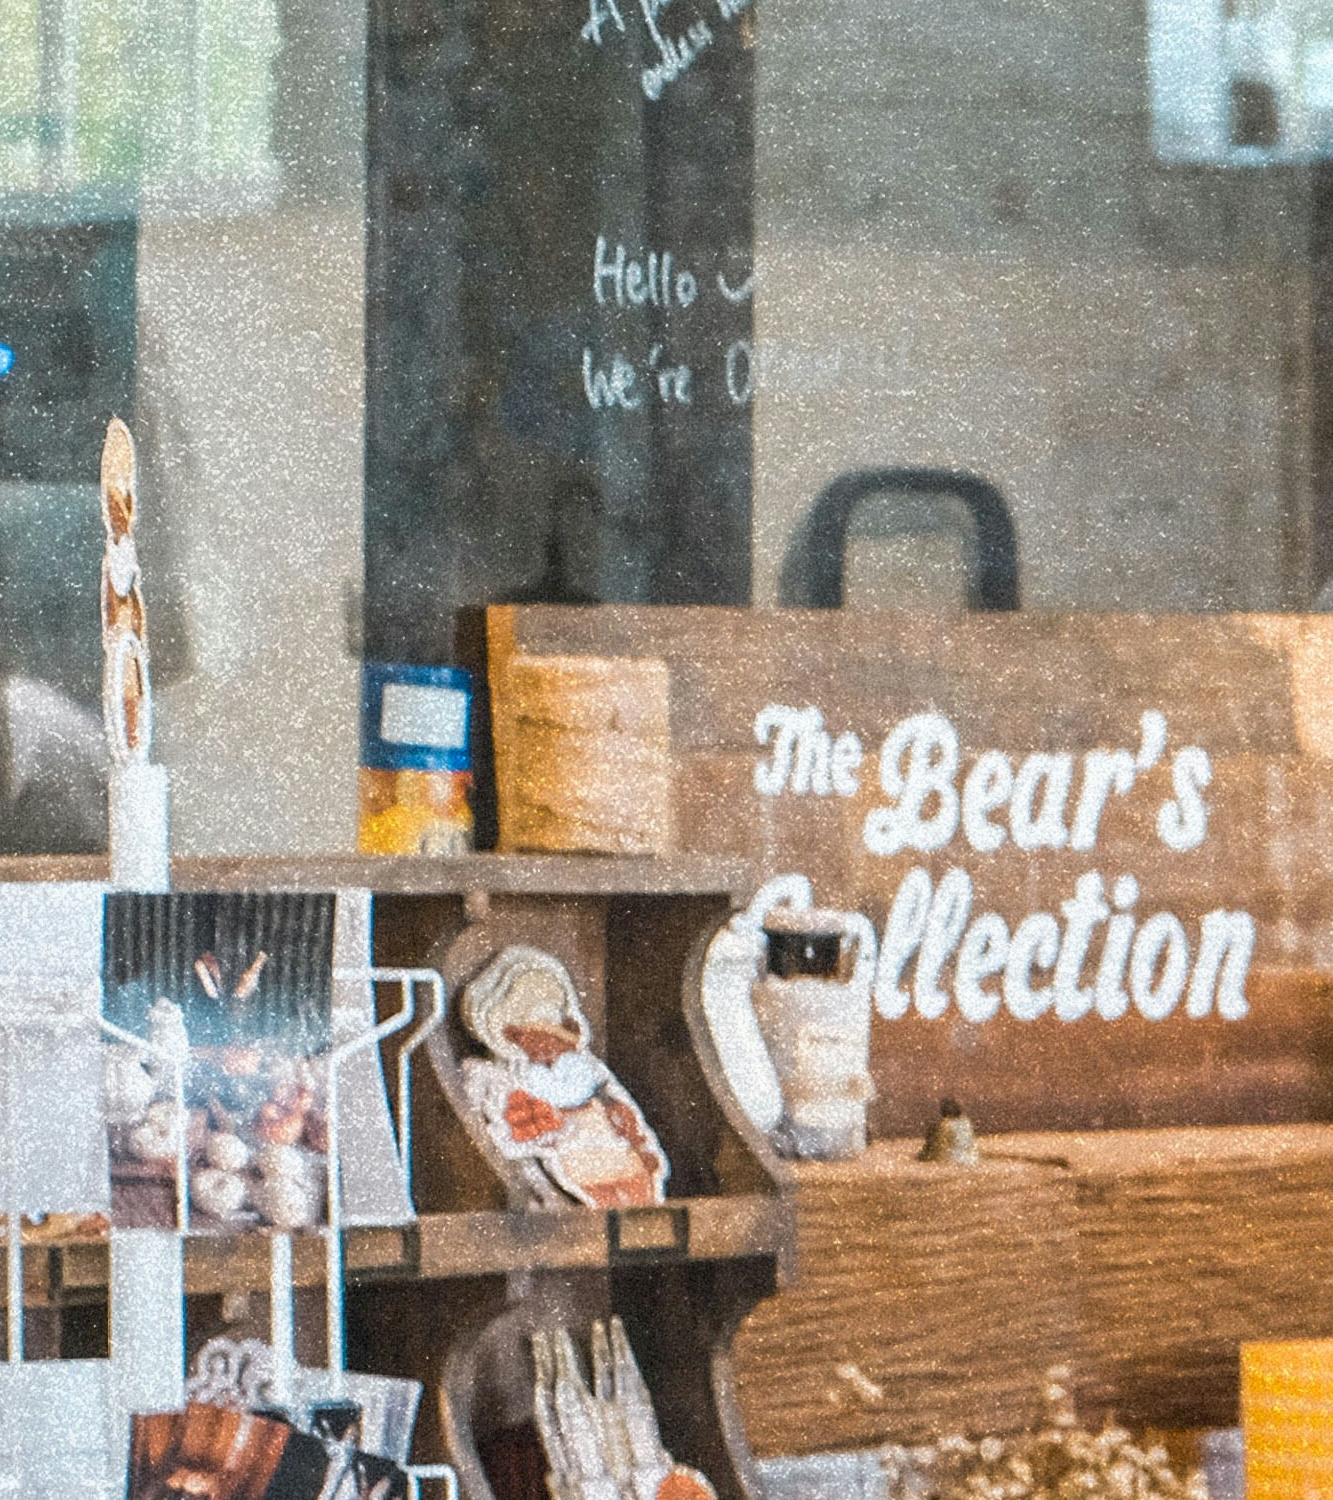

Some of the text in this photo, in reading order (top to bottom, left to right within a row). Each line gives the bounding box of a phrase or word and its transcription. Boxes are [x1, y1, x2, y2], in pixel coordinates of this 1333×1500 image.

[593, 236, 697, 306] Hello
[582, 343, 691, 408] We're
[753, 703, 1213, 855] The Bear's
